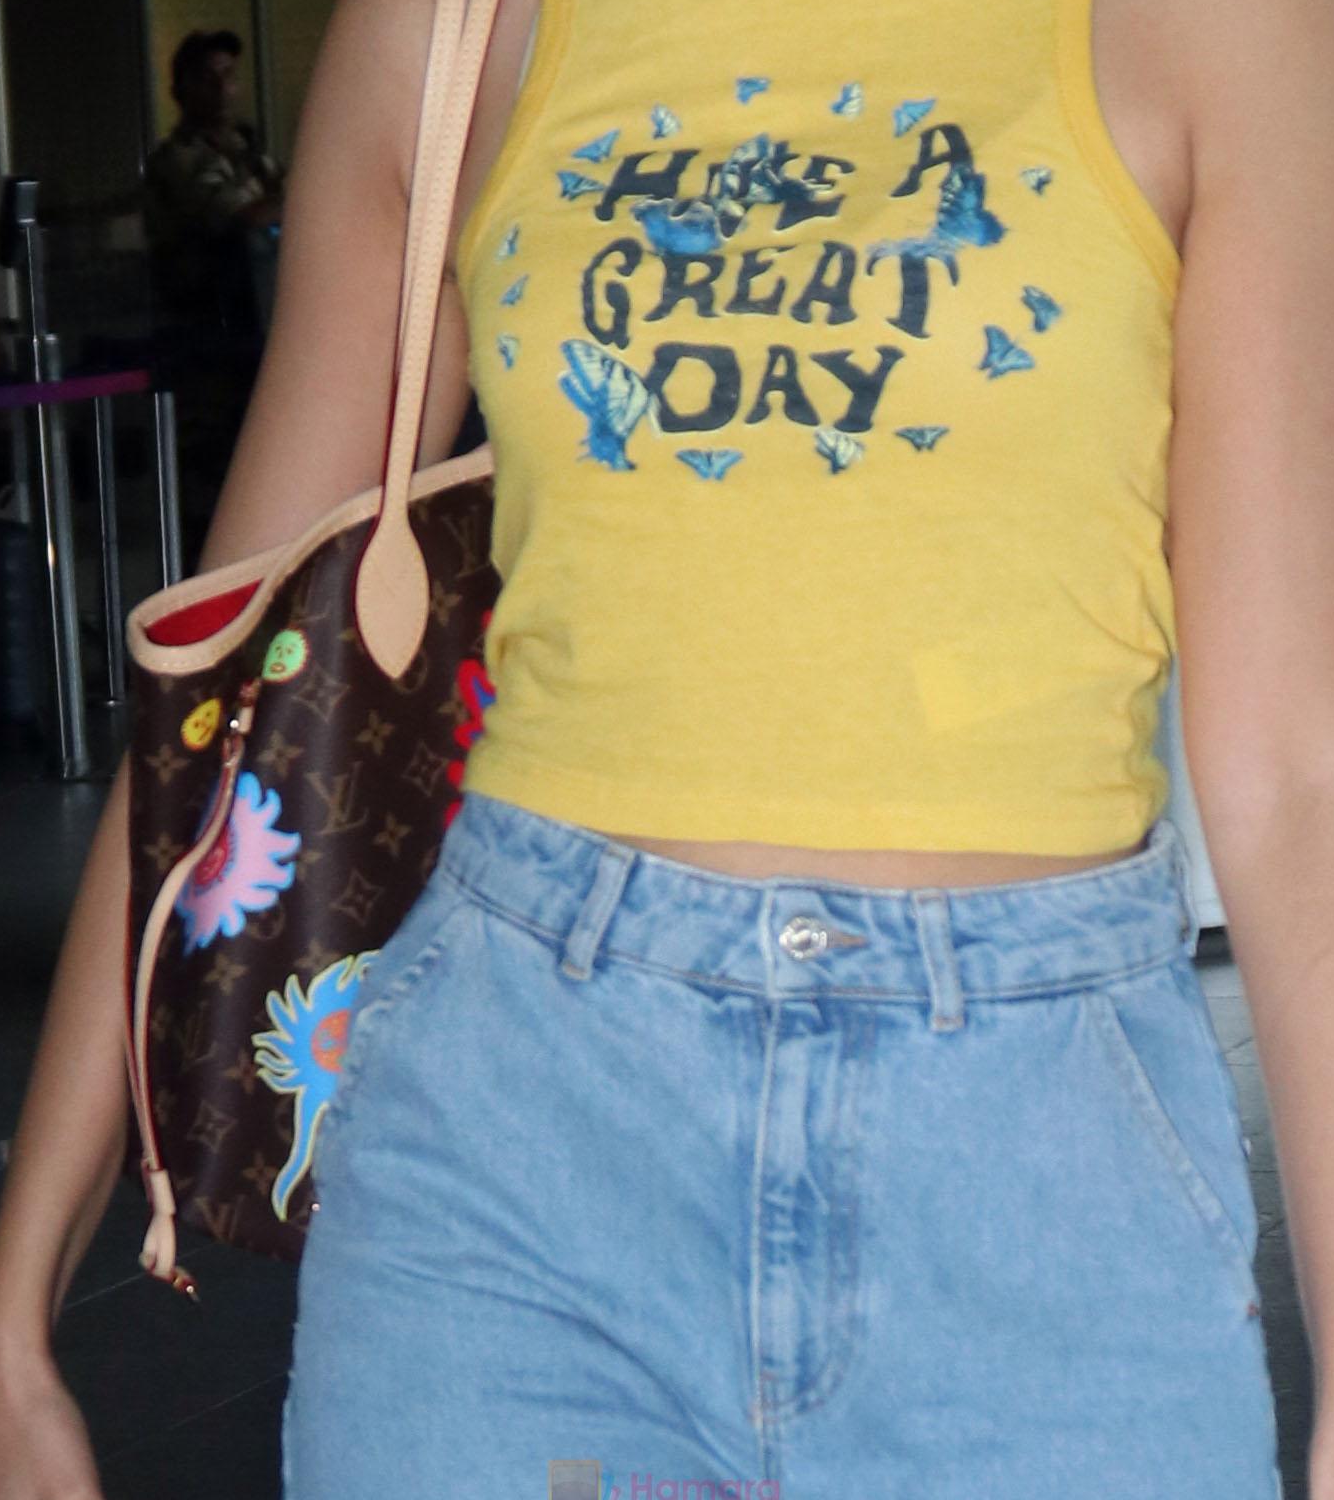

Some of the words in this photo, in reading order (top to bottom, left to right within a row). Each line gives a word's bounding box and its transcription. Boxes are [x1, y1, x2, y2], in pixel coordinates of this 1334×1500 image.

[890, 122, 974, 200] A
[581, 237, 960, 349] GREAT
[645, 342, 905, 432] DAY
